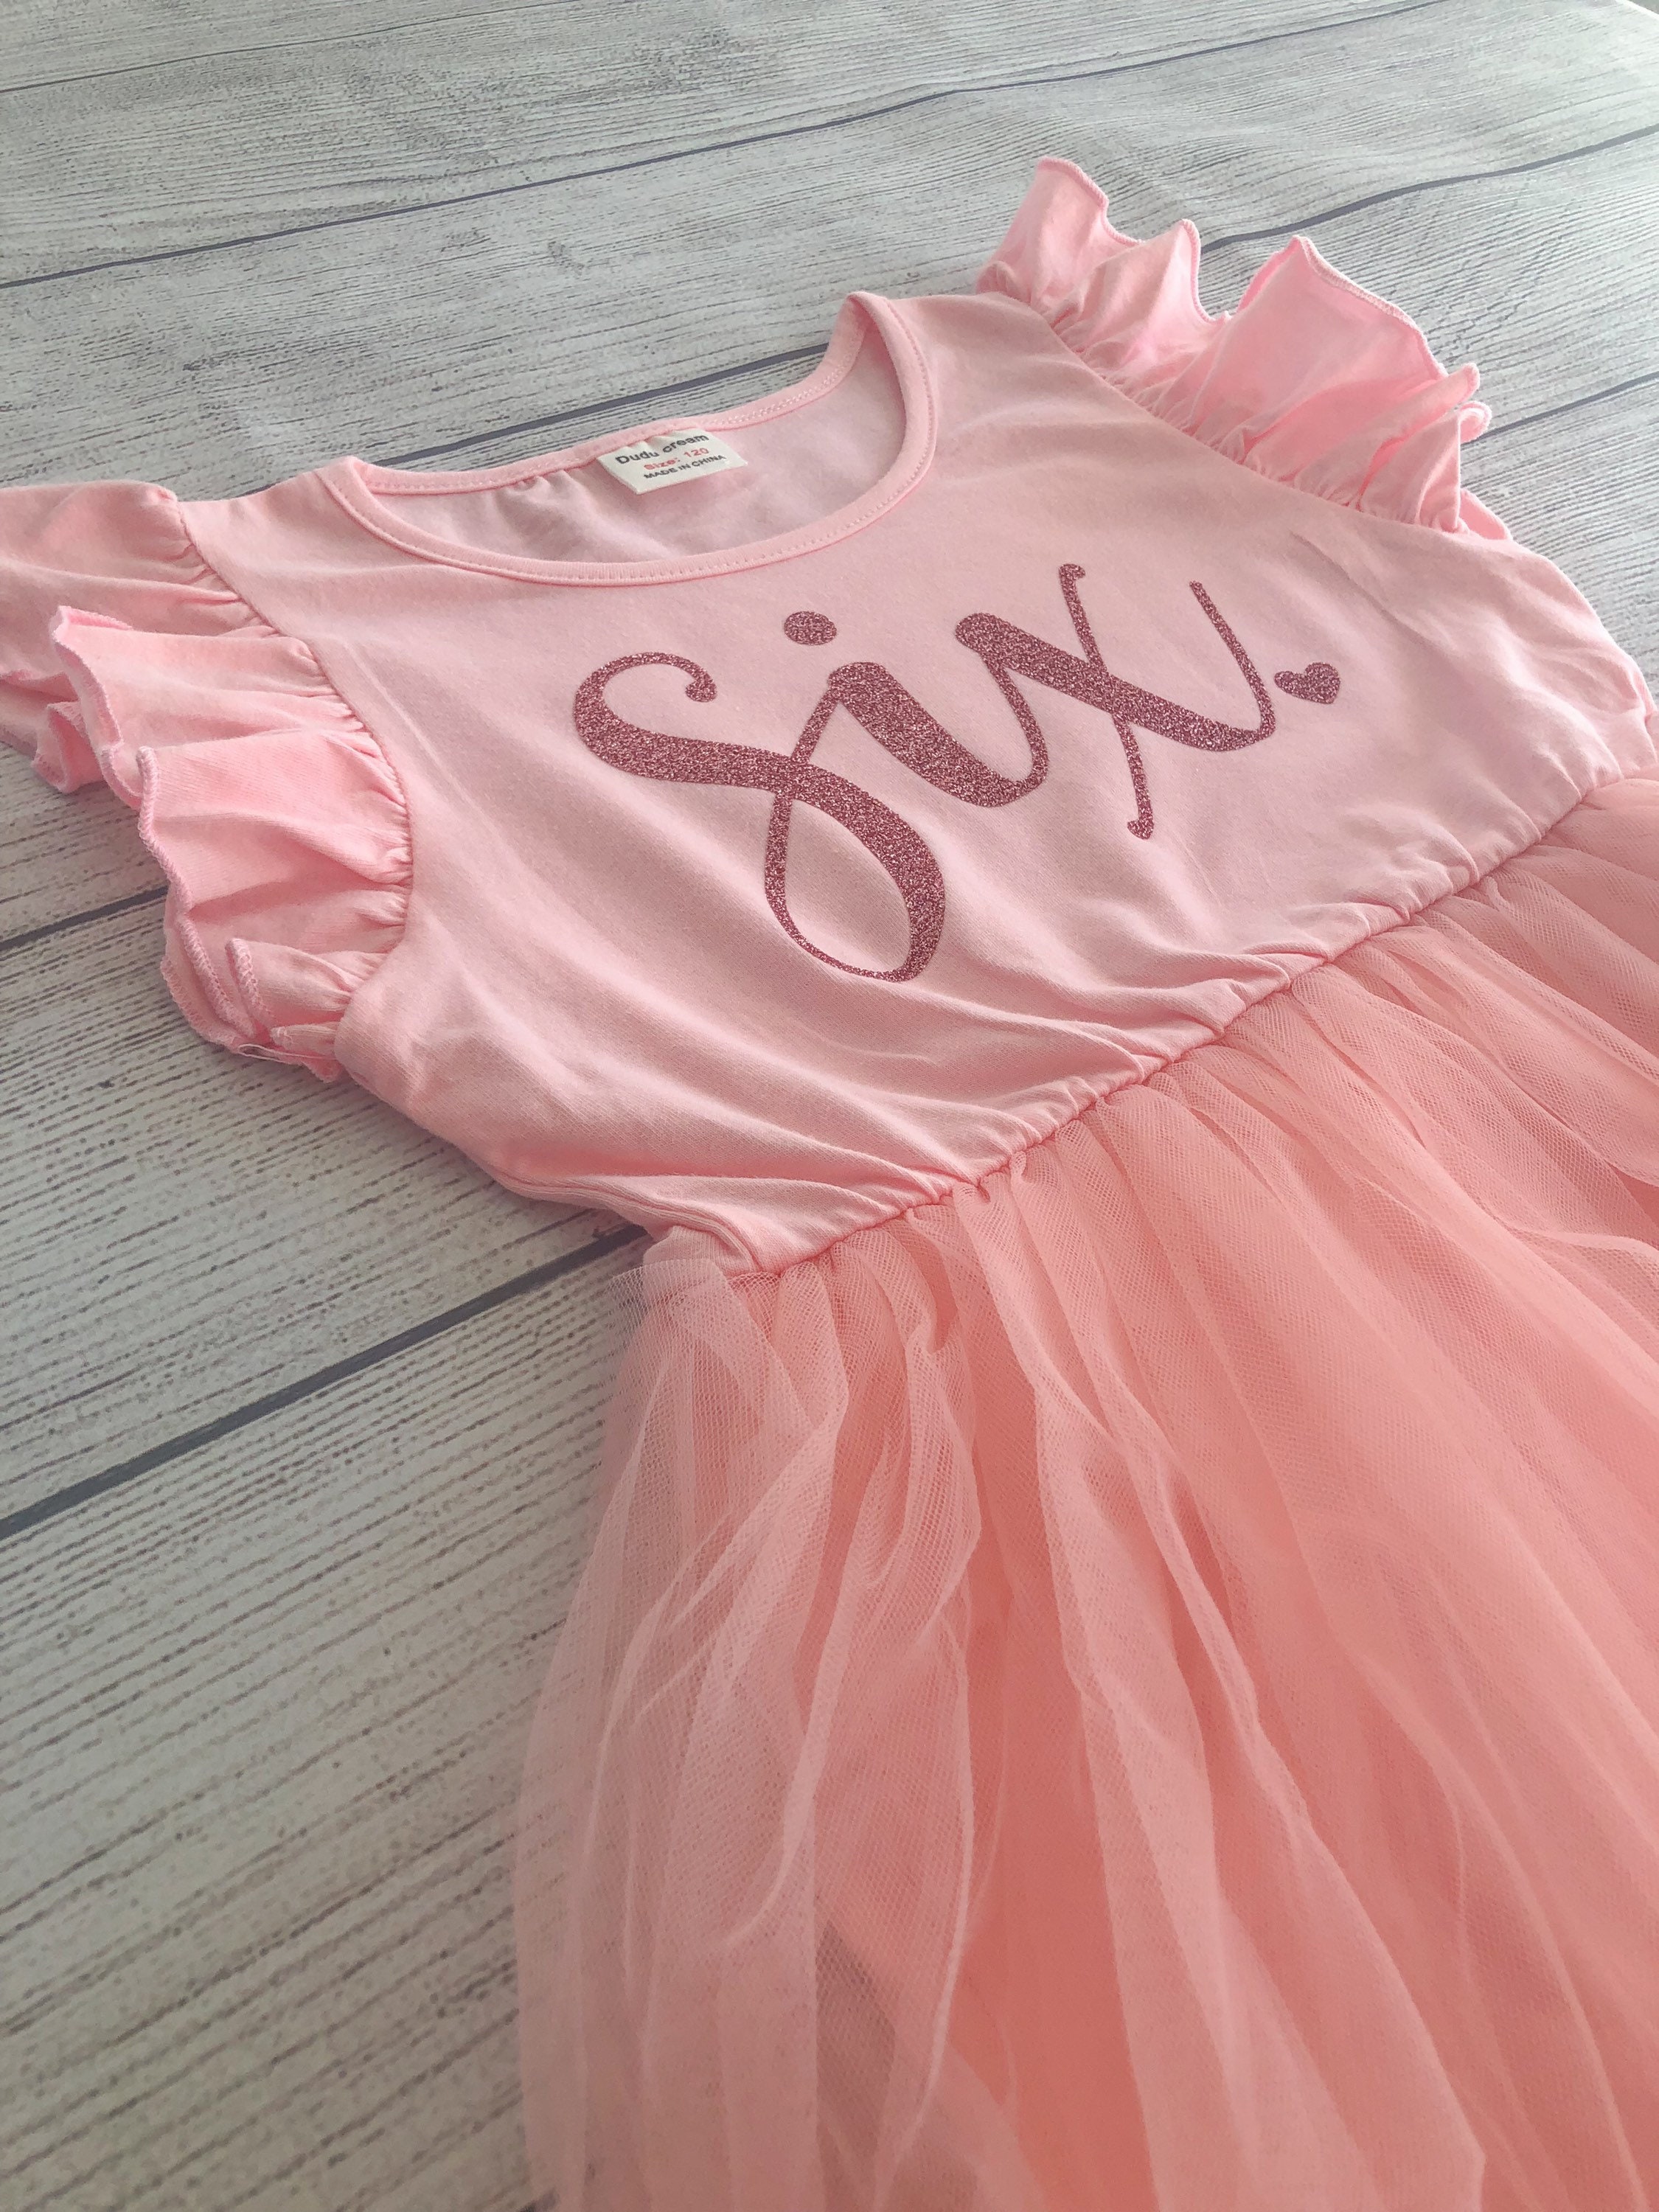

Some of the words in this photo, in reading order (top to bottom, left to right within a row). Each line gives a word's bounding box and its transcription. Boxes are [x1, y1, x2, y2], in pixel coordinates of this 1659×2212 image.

[615, 451, 659, 465] Dudu
[662, 434, 709, 453] cream
[643, 458, 681, 470] Size:
[684, 448, 709, 458] 120
[643, 467, 678, 479] MADE
[691, 455, 727, 467] CHINA
